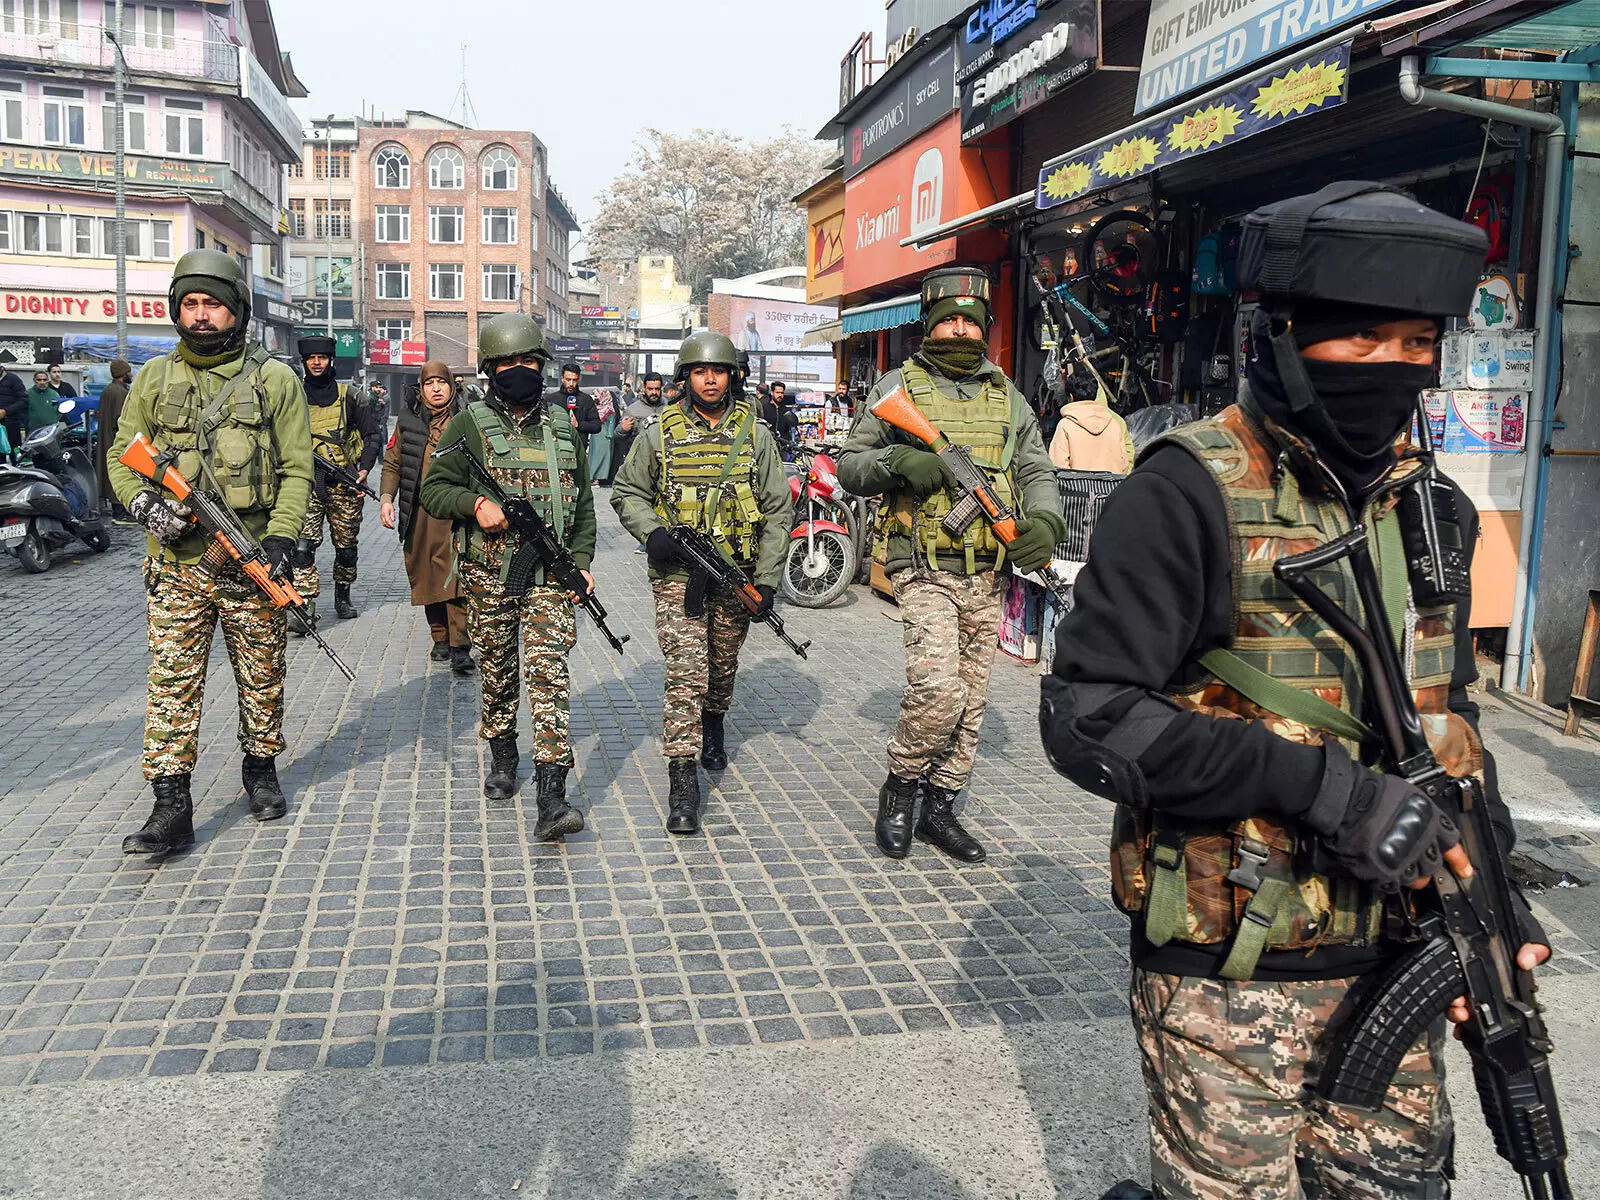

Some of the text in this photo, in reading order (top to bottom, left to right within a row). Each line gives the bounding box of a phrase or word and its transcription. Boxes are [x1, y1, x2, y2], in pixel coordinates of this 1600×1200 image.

[1151, 0, 1256, 56] GIFT EMPO
[978, 47, 994, 67] WORKS
[1141, 0, 1385, 107] UNITED TRAD
[1058, 70, 1070, 84] CYCLE
[1071, 60, 1088, 77] WORKS
[916, 78, 941, 106] SKY CELL
[862, 102, 904, 150] PORTRONICS
[1183, 116, 1218, 142] Bags
[0, 150, 62, 173] PEAK
[160, 163, 190, 172] HOTEL
[1113, 142, 1141, 170] Toys
[146, 170, 215, 184] RESTAURANT
[856, 194, 900, 251] Xiaomi
[5, 294, 166, 318] DIGNITY SLES
[1505, 361, 1530, 373] Swing
[1471, 402, 1499, 411] ANGEL
